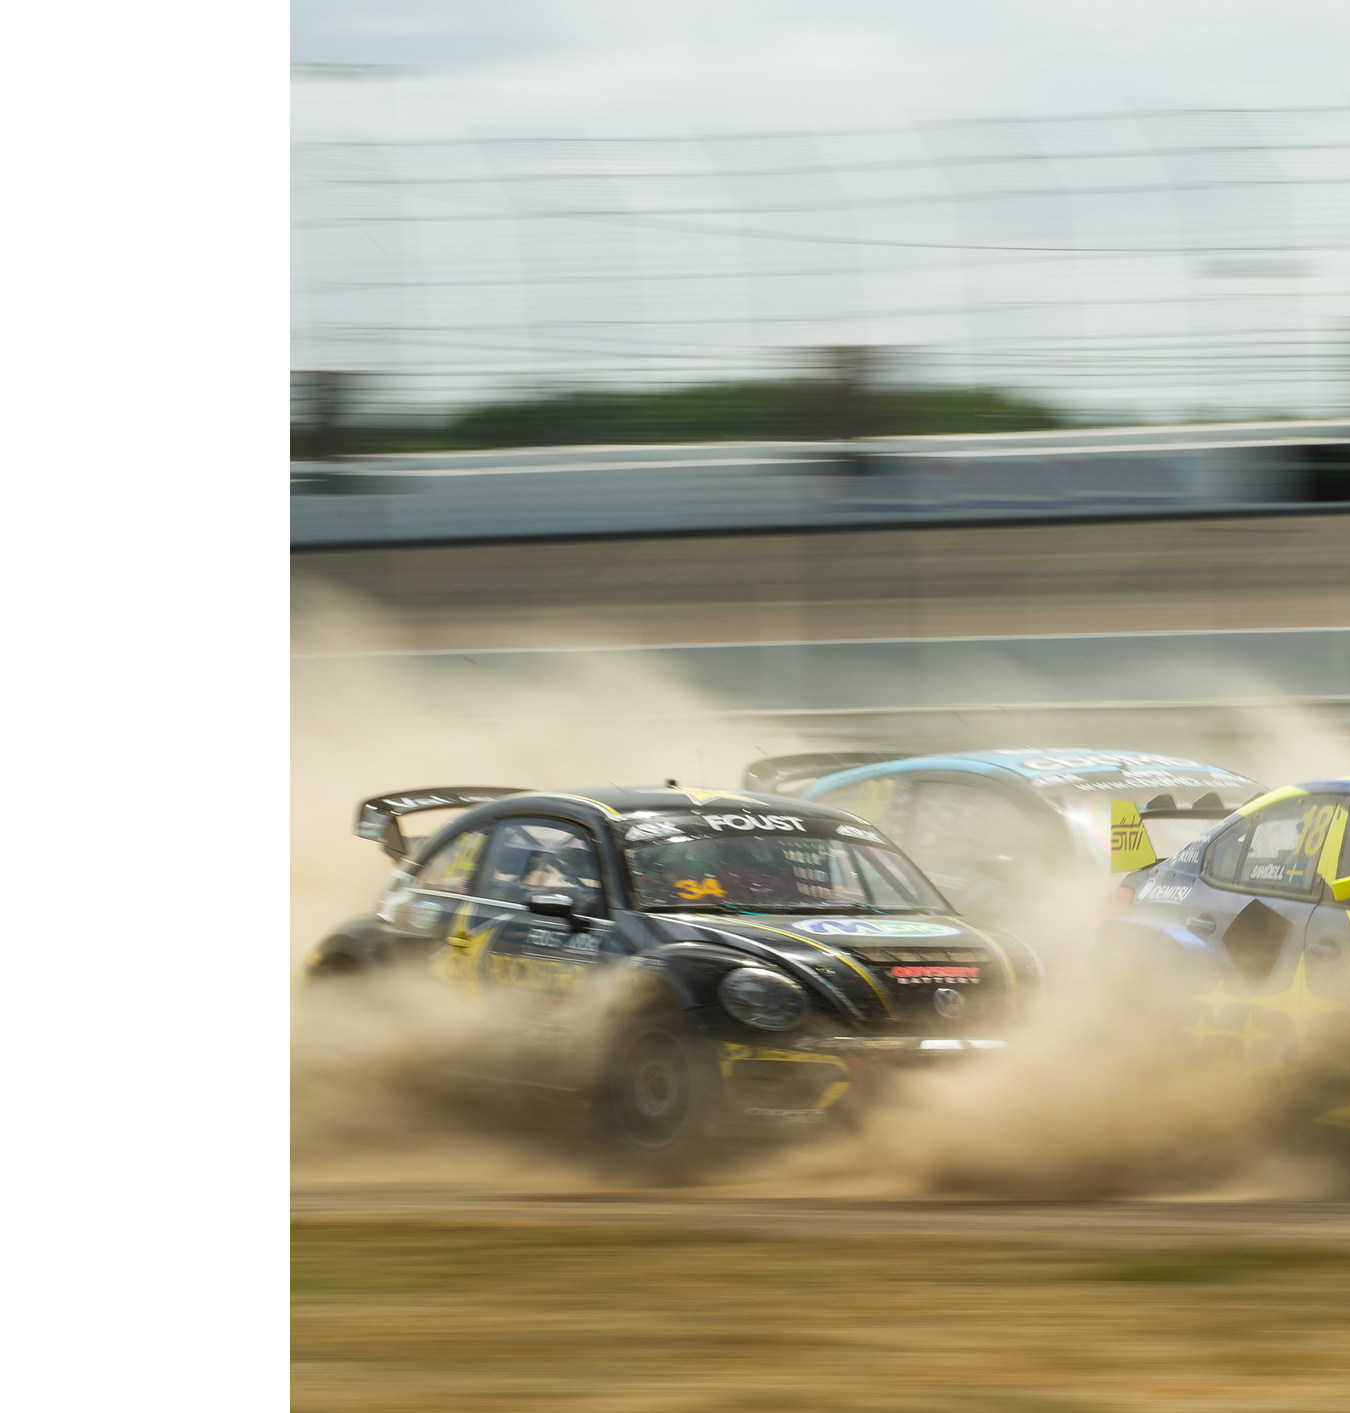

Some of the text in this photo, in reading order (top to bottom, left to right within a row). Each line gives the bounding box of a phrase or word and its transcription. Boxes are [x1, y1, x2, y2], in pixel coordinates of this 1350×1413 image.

[703, 814, 807, 832] FOUST
[1294, 804, 1334, 856] 18
[1250, 863, 1286, 880] SANDELL
[674, 877, 727, 899] 34
